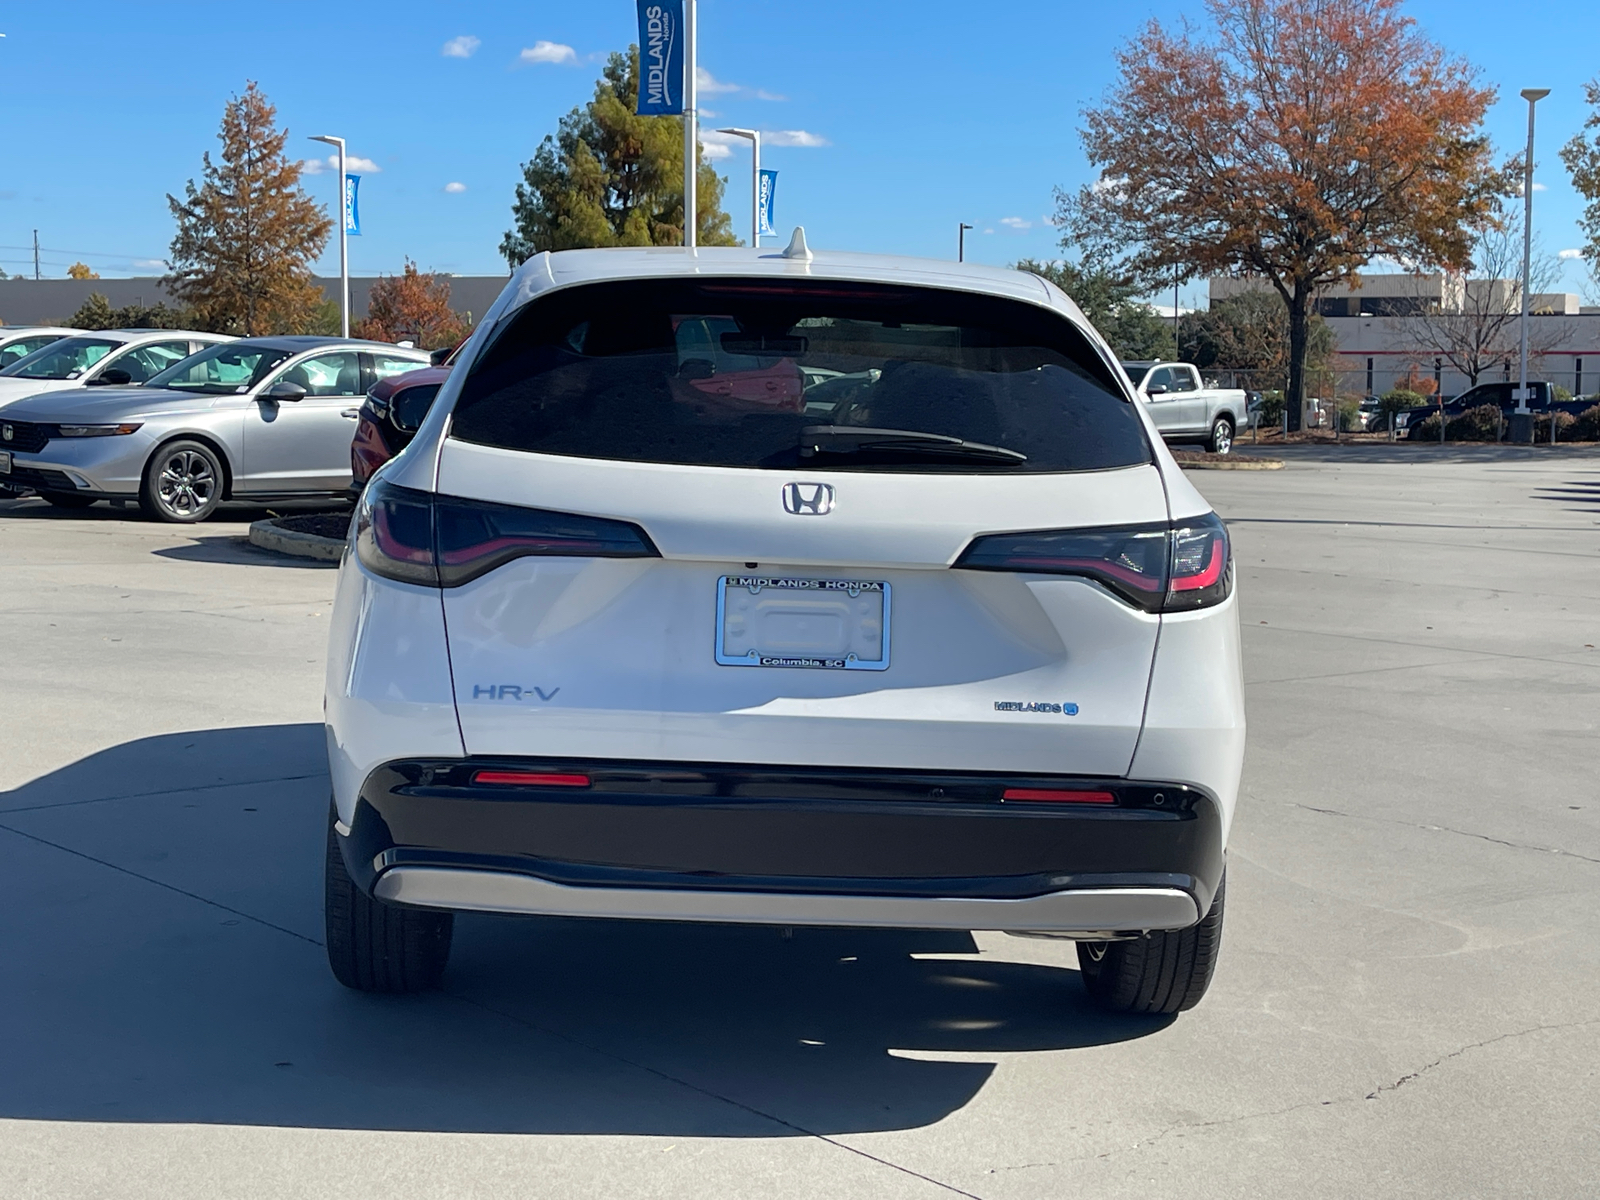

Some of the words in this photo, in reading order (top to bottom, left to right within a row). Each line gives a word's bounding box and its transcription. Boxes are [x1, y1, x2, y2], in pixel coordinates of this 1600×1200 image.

[646, 5, 662, 104] MIDLANDS
[760, 174, 769, 230] MIDLANDS
[739, 577, 820, 588] MIDLANDS
[825, 580, 881, 590] HONDA
[762, 657, 823, 667] Columbia,
[825, 660, 844, 668] SC
[473, 684, 560, 702] HR-V
[994, 701, 1062, 713] MIDLANDS
